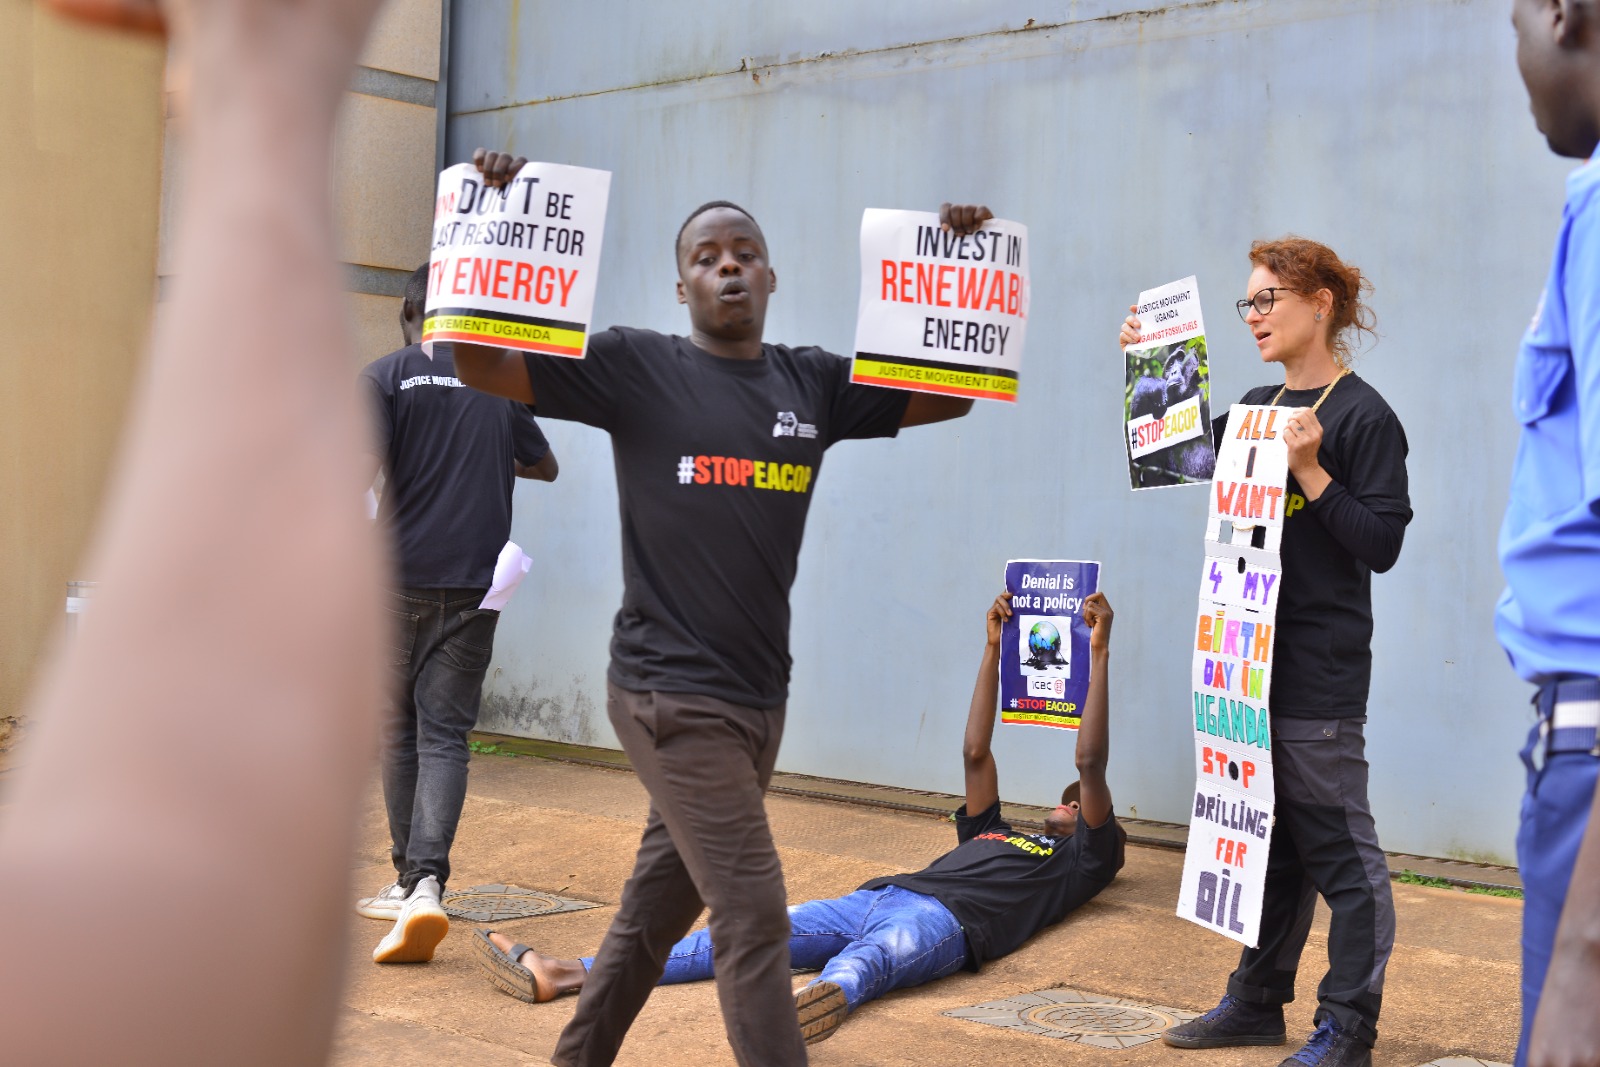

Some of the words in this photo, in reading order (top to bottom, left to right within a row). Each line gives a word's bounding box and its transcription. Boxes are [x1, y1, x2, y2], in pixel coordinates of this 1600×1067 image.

[456, 177, 540, 217] DON'T
[545, 192, 574, 220] BE
[461, 220, 539, 250] RESORT
[544, 227, 585, 256] FOR
[916, 225, 1002, 262] INVEST
[1006, 234, 1022, 268] IN
[451, 257, 578, 307] ENERGY
[881, 259, 1027, 321] RENEWABL
[1137, 300, 1160, 315] JUSTICE
[1160, 290, 1191, 308] MOVEMENT
[1154, 309, 1179, 323] UGANDA
[493, 323, 551, 341] UGANDA
[923, 316, 1010, 356] ENERGY
[1182, 320, 1198, 333] FUELS
[400, 375, 431, 391] JUSTICE
[878, 365, 922, 380] JUSTICE
[924, 370, 989, 388] MOVEMENT
[1131, 404, 1198, 450] #STOPEACOP
[1236, 409, 1278, 440] ALL
[677, 455, 812, 493] #STOPEACOP
[1245, 446, 1257, 478] I
[1217, 481, 1283, 520] WANT
[1021, 573, 1060, 590] Denial
[1062, 574, 1074, 590] is
[1209, 561, 1223, 594] 4
[1242, 571, 1277, 605] MY
[1012, 594, 1031, 608] not
[1033, 596, 1041, 608] a
[1043, 593, 1082, 614] policy
[1203, 658, 1235, 691] DAY
[1010, 698, 1076, 713] #STOPEACOP
[1194, 691, 1270, 751] UGANDA
[1202, 746, 1256, 788] STOP
[1216, 837, 1247, 868] FOR
